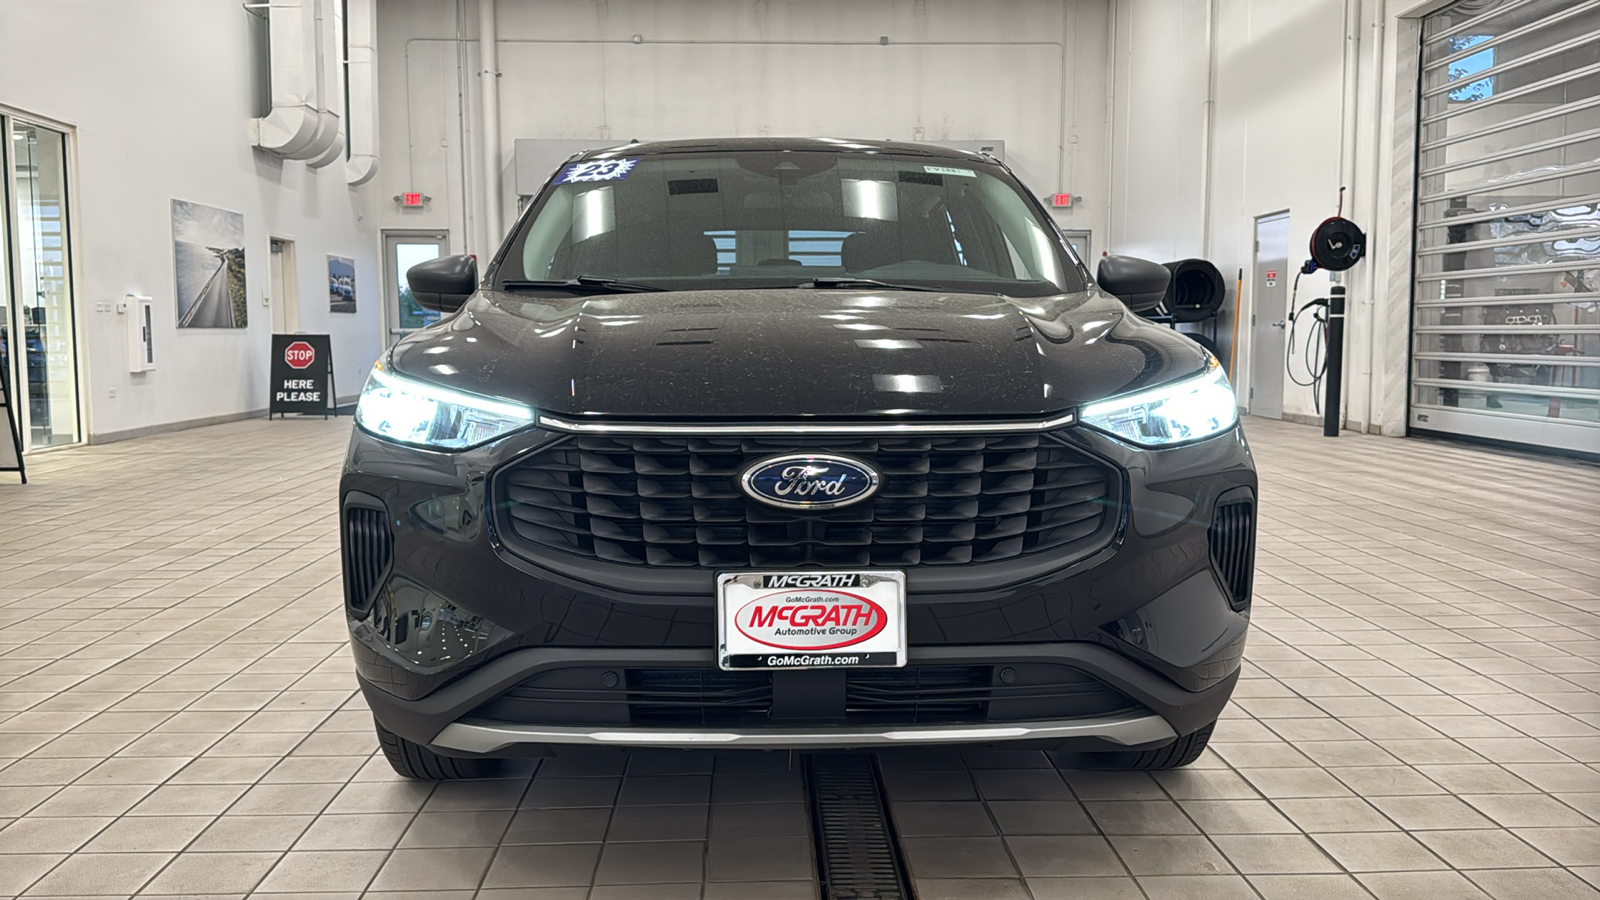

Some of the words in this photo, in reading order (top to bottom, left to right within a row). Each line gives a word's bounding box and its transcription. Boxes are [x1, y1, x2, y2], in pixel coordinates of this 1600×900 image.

[576, 163, 620, 177] 23
[287, 350, 313, 360] STOP
[283, 379, 314, 389] HERE
[276, 392, 320, 401] PLEASE
[774, 466, 847, 496] Ford
[774, 627, 827, 636] Automotive
[829, 627, 857, 637] Group
[767, 655, 859, 667] GoMcGrath.com
